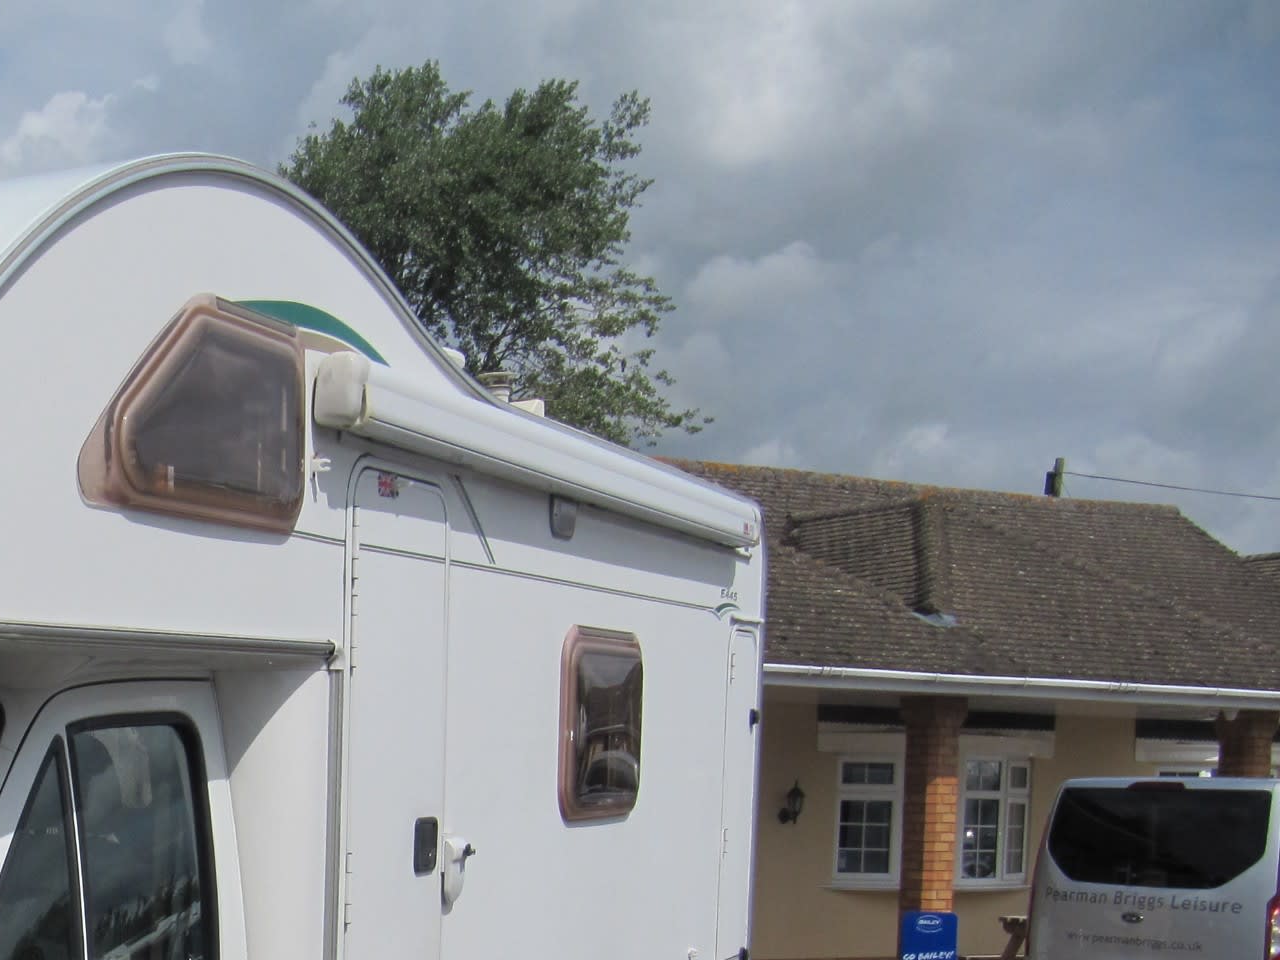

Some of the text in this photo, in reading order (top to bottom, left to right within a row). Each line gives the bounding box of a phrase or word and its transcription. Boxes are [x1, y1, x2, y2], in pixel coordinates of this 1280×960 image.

[1045, 886, 1243, 915] Pearman Briggs Leisure
